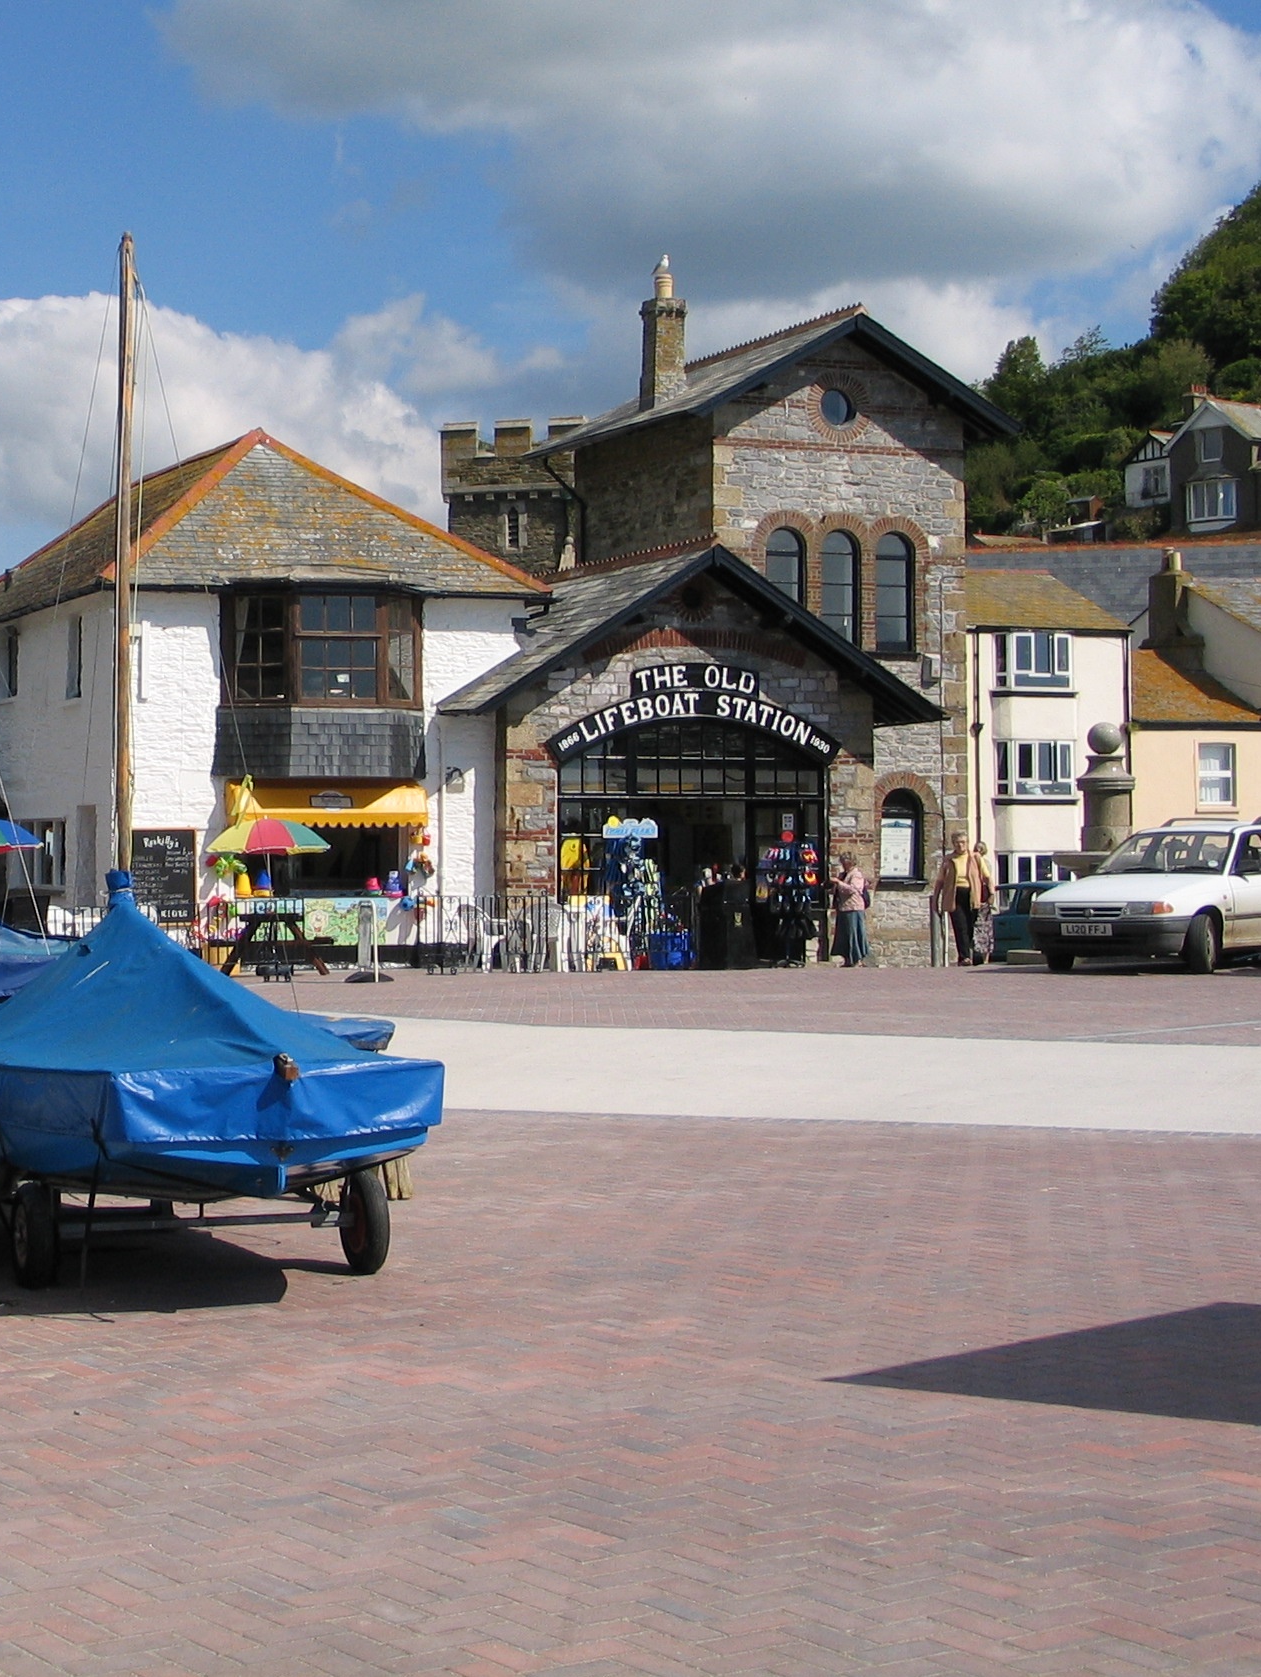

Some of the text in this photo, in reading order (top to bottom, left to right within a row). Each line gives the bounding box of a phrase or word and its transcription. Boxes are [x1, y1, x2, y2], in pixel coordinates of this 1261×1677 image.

[635, 665, 755, 694] THE OLD
[578, 693, 700, 743] LIFEBOAT
[716, 694, 812, 746] STATION
[810, 734, 831, 754] 1930
